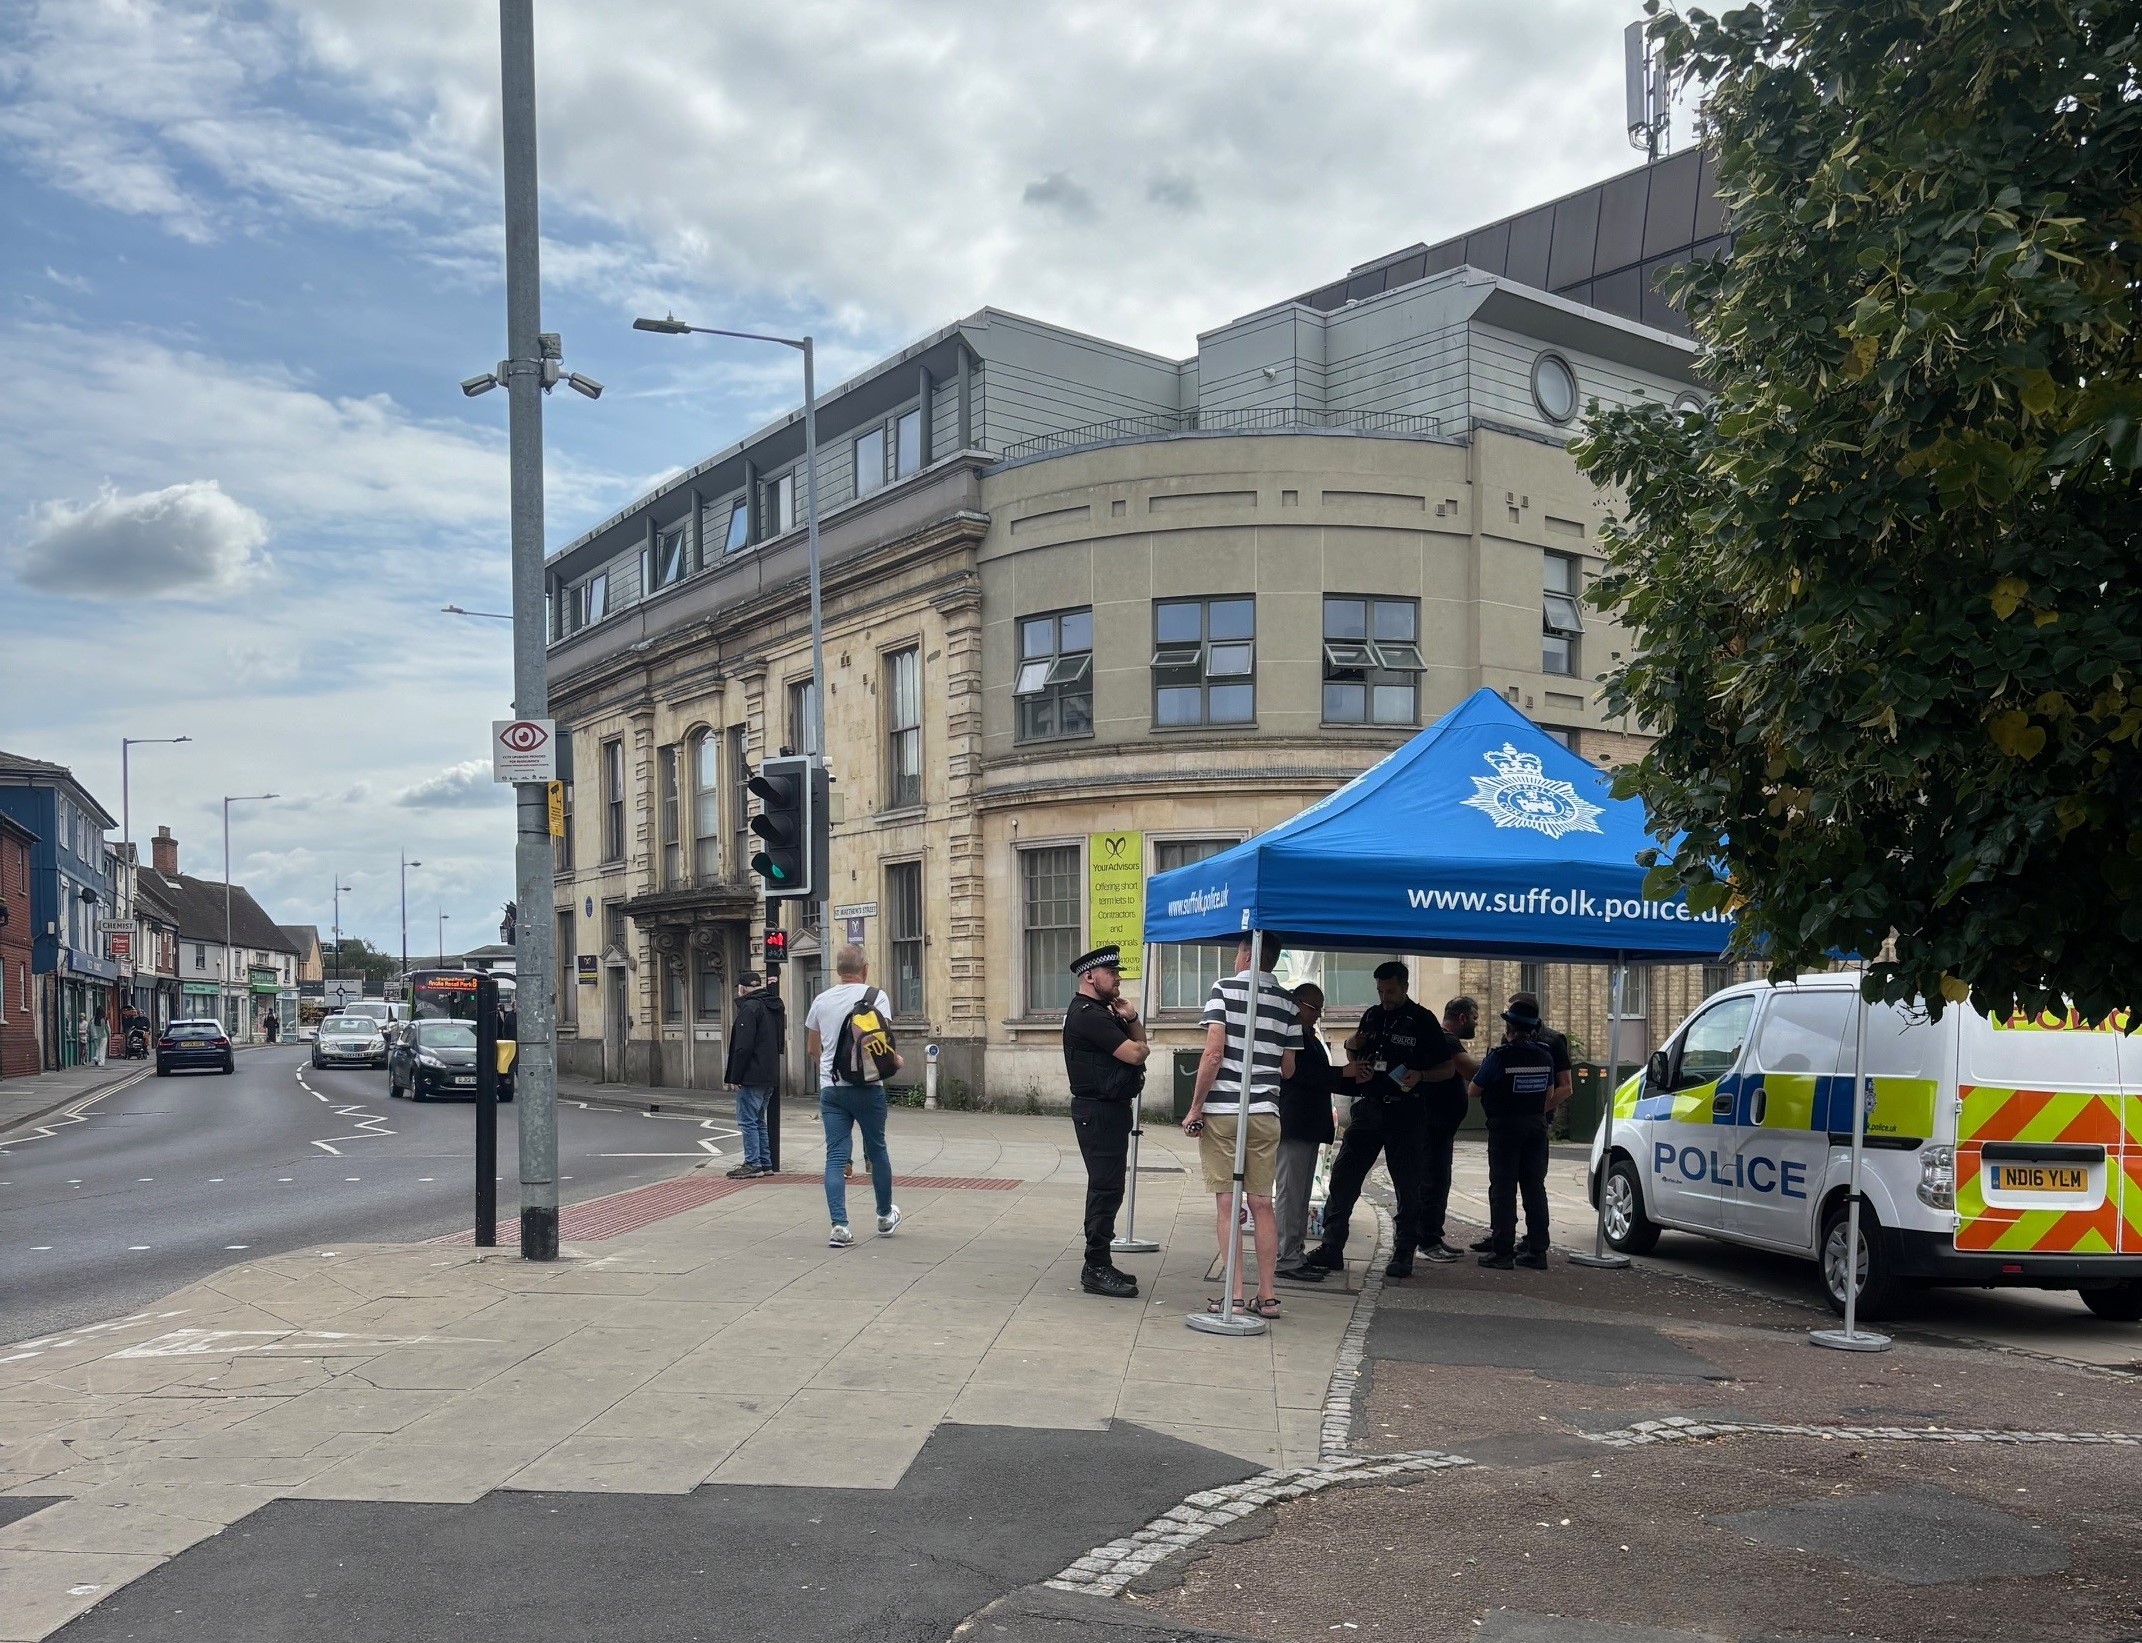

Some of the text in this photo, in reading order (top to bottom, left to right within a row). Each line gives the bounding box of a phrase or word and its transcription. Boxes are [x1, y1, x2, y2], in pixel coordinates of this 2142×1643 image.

[1503, 784, 1555, 797] SUFFOLK
[1093, 862, 1139, 872] YourAdvisors
[1095, 882, 1138, 892] Offering short
[1099, 896, 1135, 905] term lets to
[1168, 882, 1229, 917] www.suffolk.police.uk
[1097, 910, 1136, 919] Contractors
[102, 922, 133, 930] CHEMIST
[1110, 925, 1123, 933] and
[1096, 939, 1138, 947] professionals
[1392, 1035, 1416, 1046] POLICE
[864, 1039, 896, 1056] FOX
[1654, 1141, 1807, 1200] POLICE
[2006, 1168, 2081, 1188] ND16 YLM
